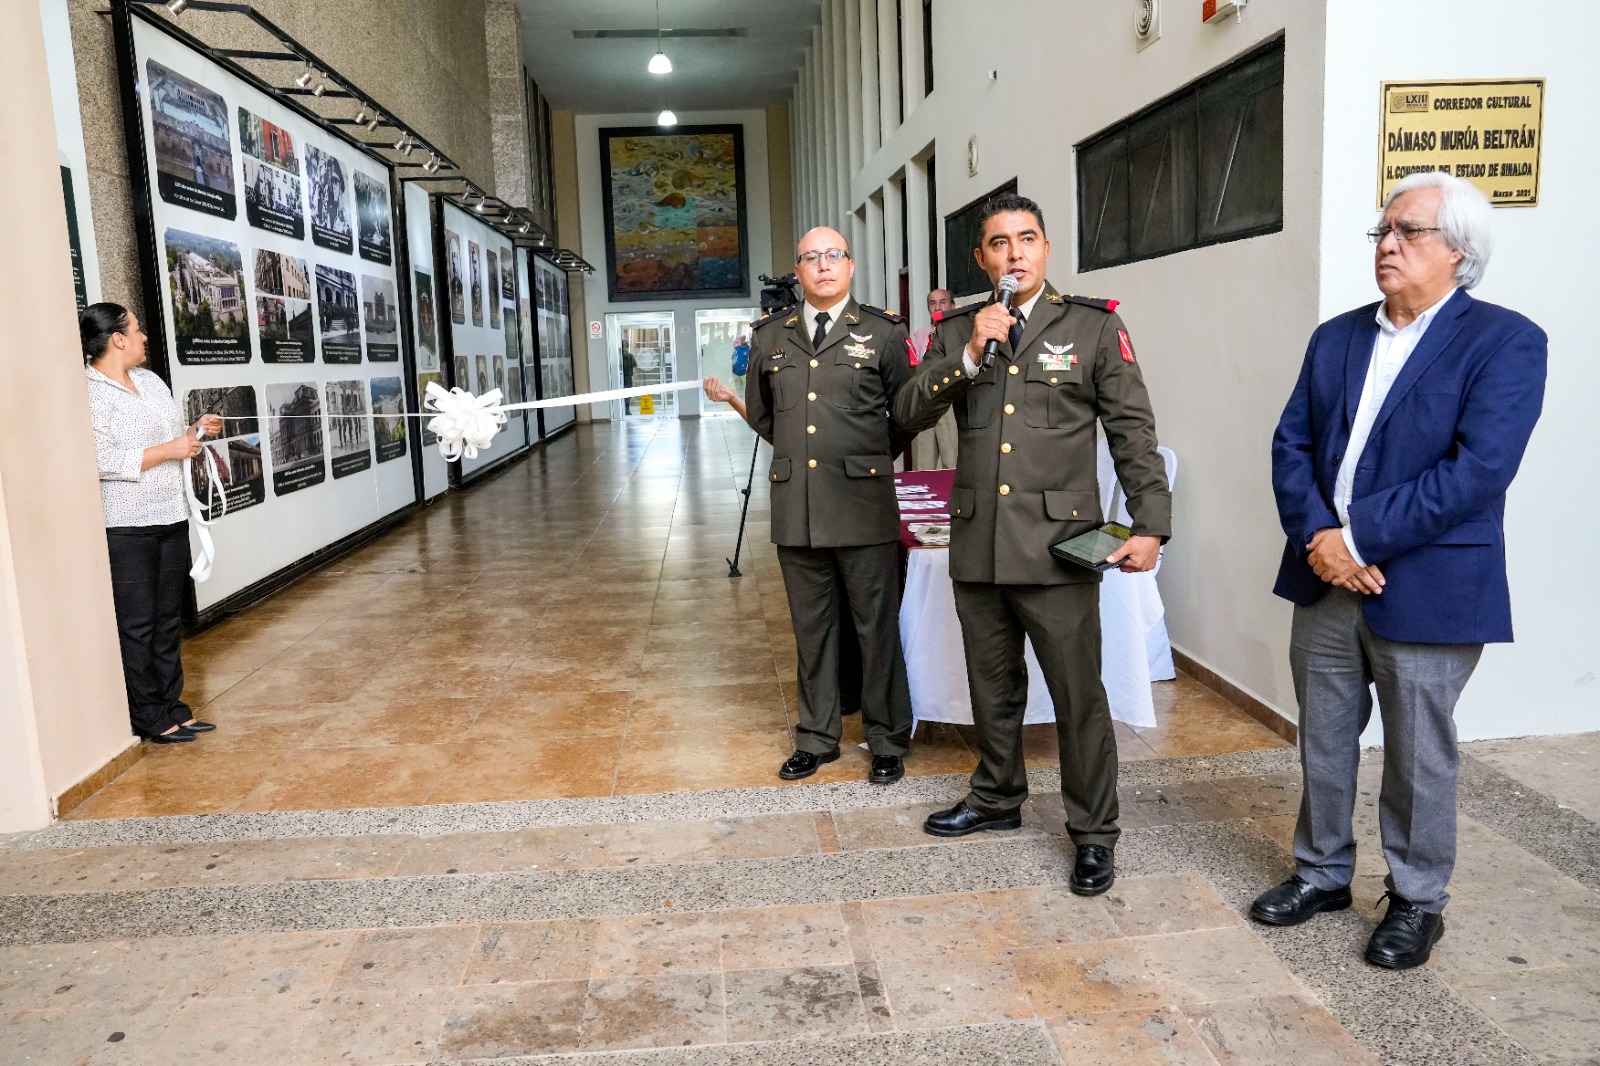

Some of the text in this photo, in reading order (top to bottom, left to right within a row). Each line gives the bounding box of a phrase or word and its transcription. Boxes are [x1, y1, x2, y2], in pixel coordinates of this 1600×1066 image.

[1405, 94, 1428, 104] LXIII
[1433, 97, 1483, 110] CORREDOR
[1486, 95, 1532, 109] CULTURAL
[1388, 124, 1536, 152] DÁMASO MURÚA BELTRÁN
[1456, 163, 1486, 178] ESTADO
[1487, 163, 1499, 177] DE
[1500, 161, 1532, 176] SINALOA
[1493, 189, 1531, 198] Marzo 2021
